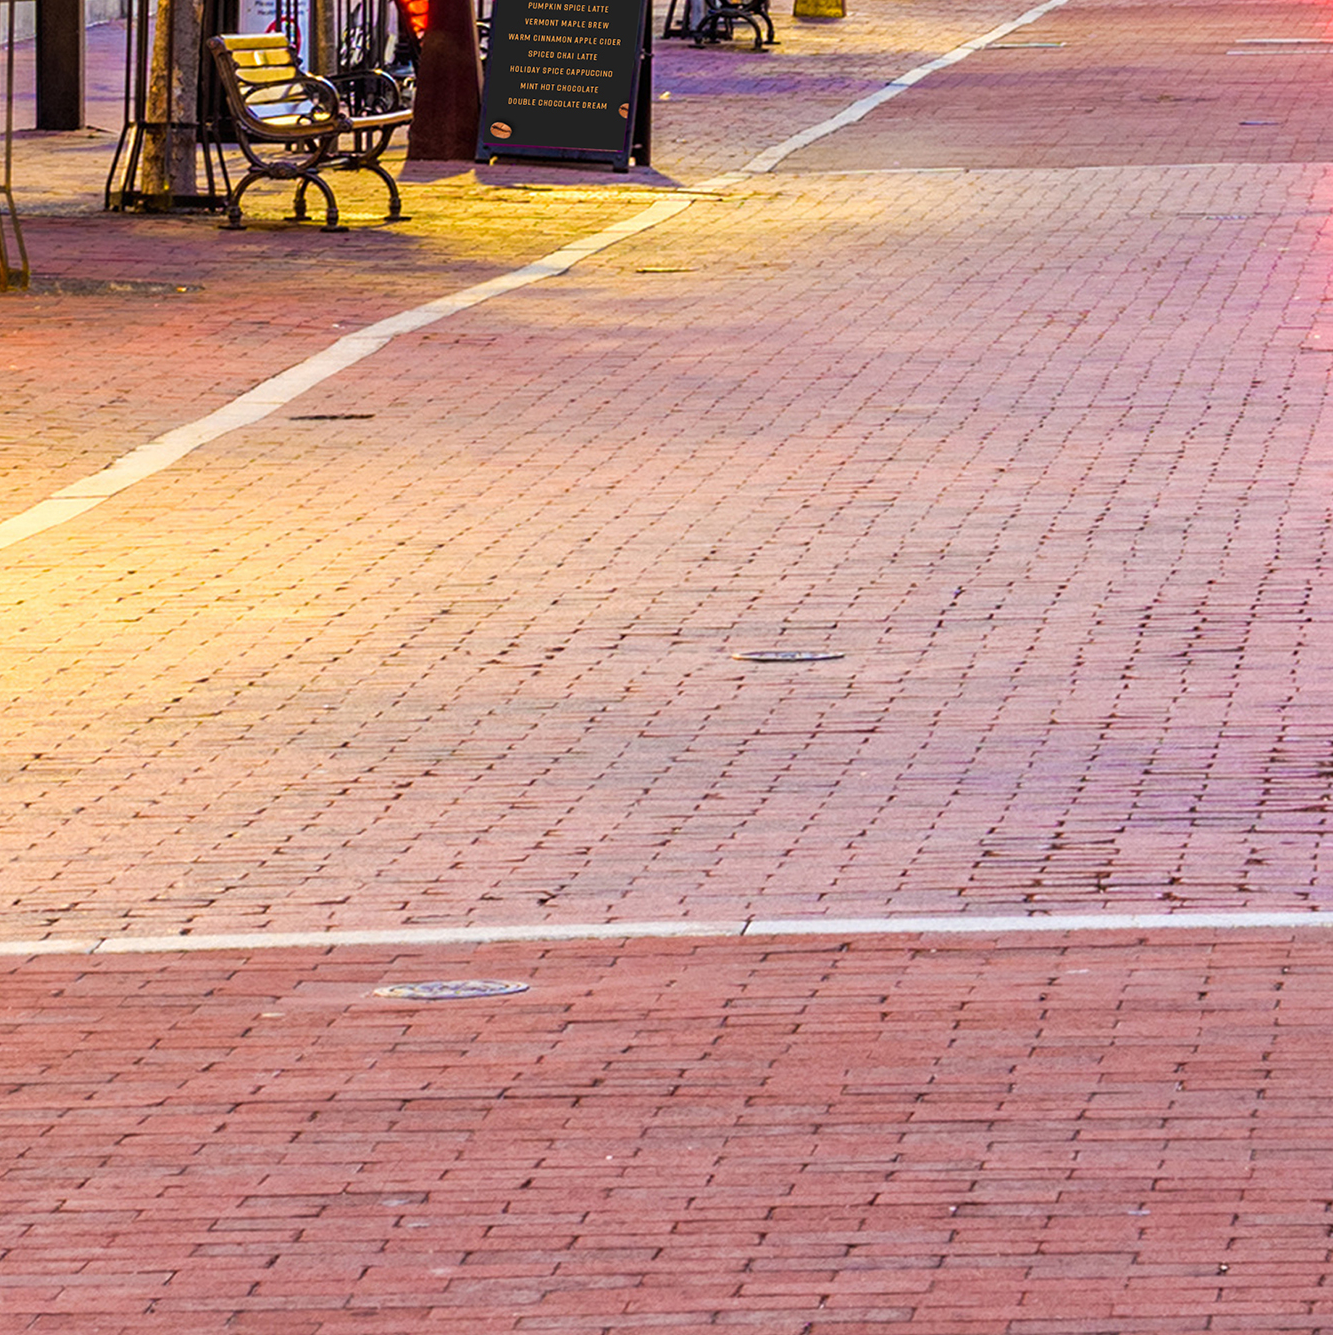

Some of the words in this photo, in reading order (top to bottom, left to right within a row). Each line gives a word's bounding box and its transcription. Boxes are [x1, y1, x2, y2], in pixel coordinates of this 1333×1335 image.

[528, 2, 562, 11] PUMPKIN
[563, 3, 586, 12] SPICE
[587, 5, 609, 13] LATTE
[525, 18, 559, 27] VERMONT
[561, 20, 586, 29] MAPLE
[587, 21, 610, 29] BREW
[508, 33, 531, 41] WARM
[533, 34, 572, 43] CINNAMON
[574, 36, 597, 45] APPLE
[599, 38, 622, 46] CIDER
[528, 50, 555, 59] SPICED
[556, 52, 574, 60] CHAI
[576, 53, 598, 61] LATTE
[509, 65, 540, 74] HOLIDAY
[542, 67, 564, 75] SPICE
[565, 68, 613, 78] CAPPUCCINO
[520, 82, 539, 90] MINT
[540, 83, 555, 91] HOT
[556, 84, 599, 94] CHOCOLATE
[508, 97, 536, 106] DOUBLE
[538, 99, 580, 109] CHOCOLATE
[582, 101, 608, 110] DREAM
